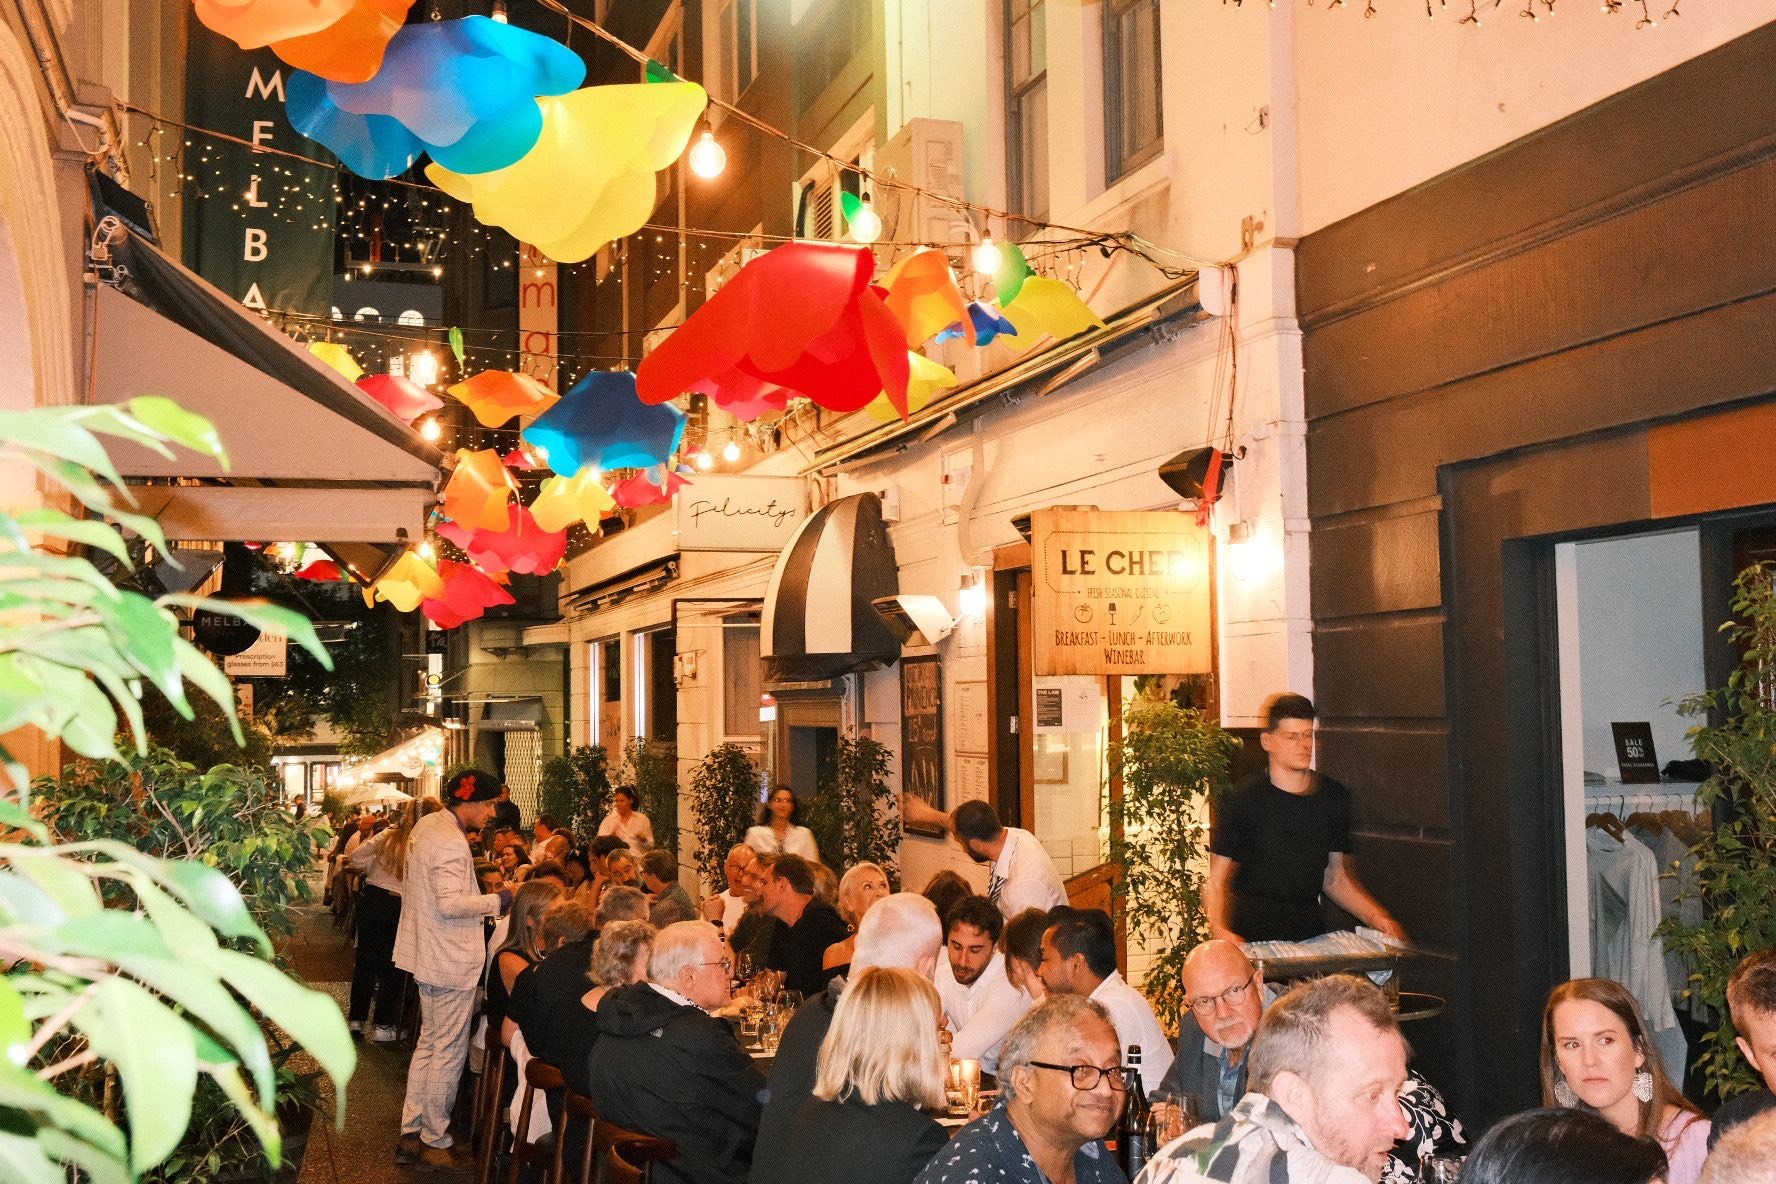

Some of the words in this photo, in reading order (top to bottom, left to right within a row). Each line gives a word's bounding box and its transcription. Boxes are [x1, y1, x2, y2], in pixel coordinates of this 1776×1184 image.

[242, 66, 286, 316] MELBA
[1061, 550, 1096, 575] LE
[1055, 630, 1098, 646] BREAKFAST
[1108, 630, 1136, 646] LUNCH
[1145, 630, 1192, 646] AFTERWORK
[1104, 648, 1146, 665] WINEBAR
[1624, 738, 1643, 747] SALE
